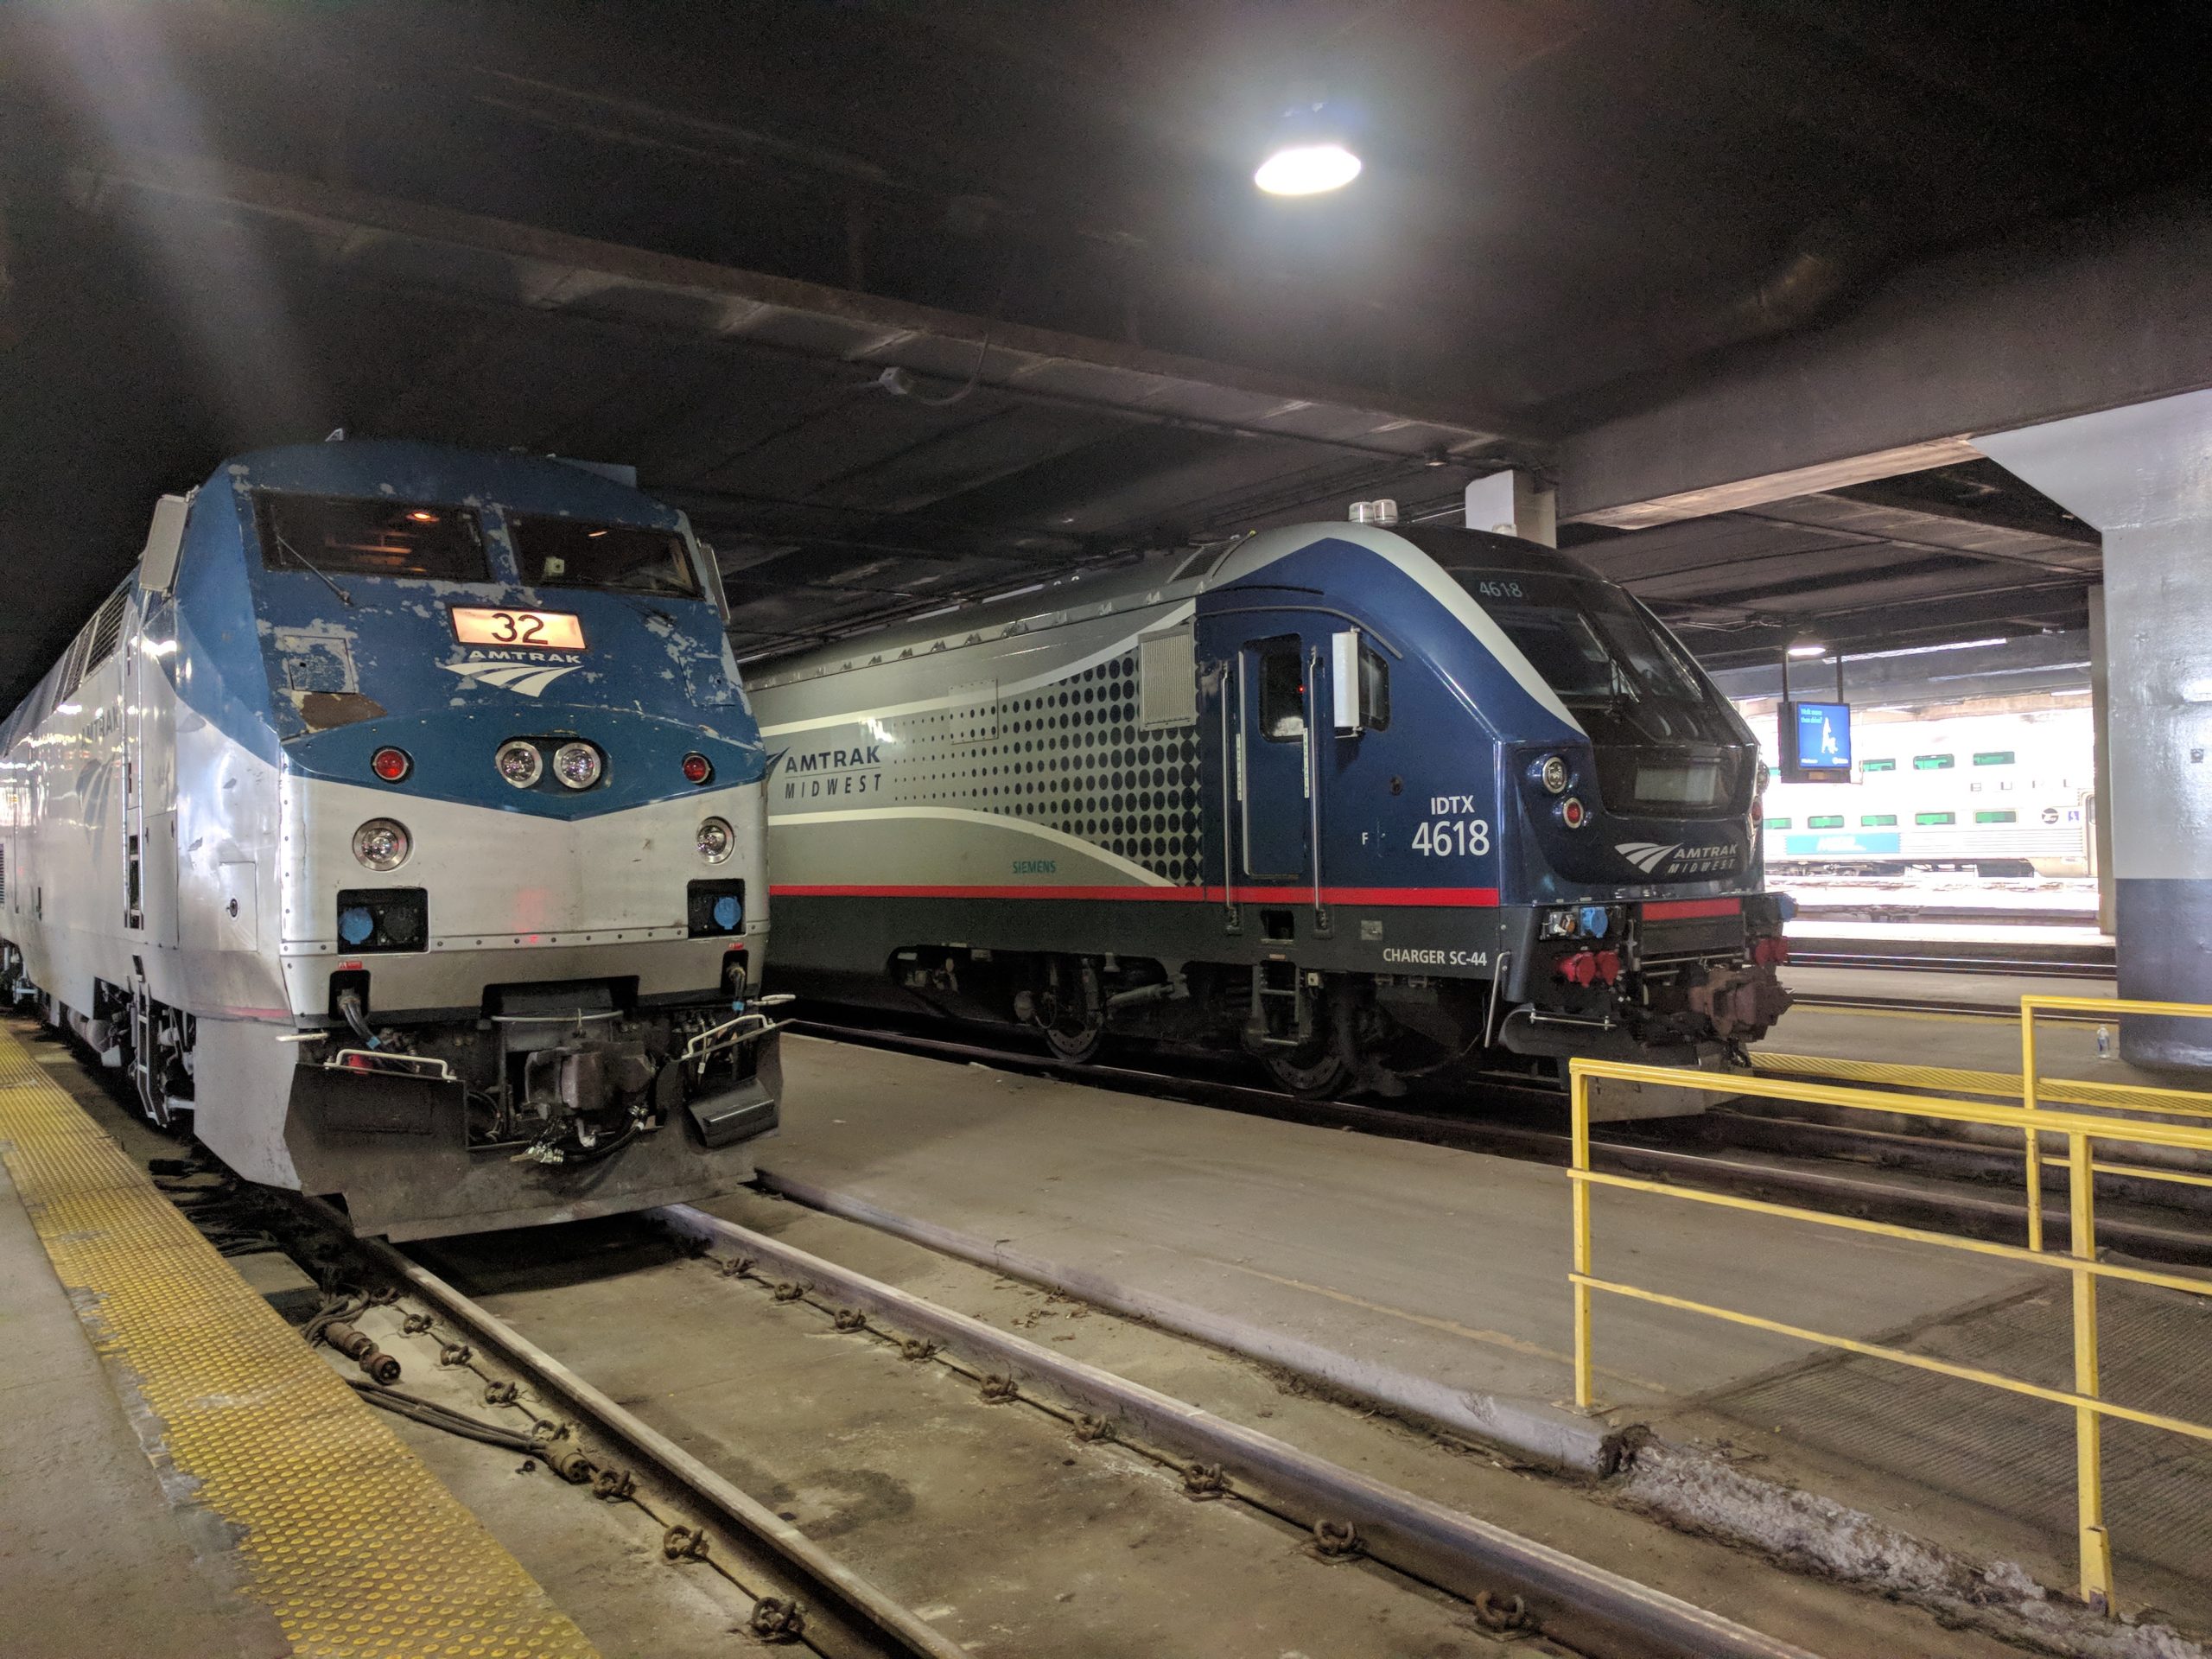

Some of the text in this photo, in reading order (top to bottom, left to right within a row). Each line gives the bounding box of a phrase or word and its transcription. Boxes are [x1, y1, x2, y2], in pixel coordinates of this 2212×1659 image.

[1480, 582, 1522, 597] 4618
[492, 613, 549, 645] 32
[469, 650, 582, 664] AMTRAK
[785, 745, 880, 773] AMTRAK
[785, 774, 881, 799] MIDWEST
[1431, 795, 1475, 815] IDTX
[1361, 831, 1369, 846] F
[1412, 819, 1491, 856] 4618
[1673, 843, 1738, 859] AMTRAK
[1012, 860, 1057, 874] SIEMENS
[1667, 859, 1736, 874] MIDWEST
[1382, 948, 1488, 967] CHARGER SC-44
